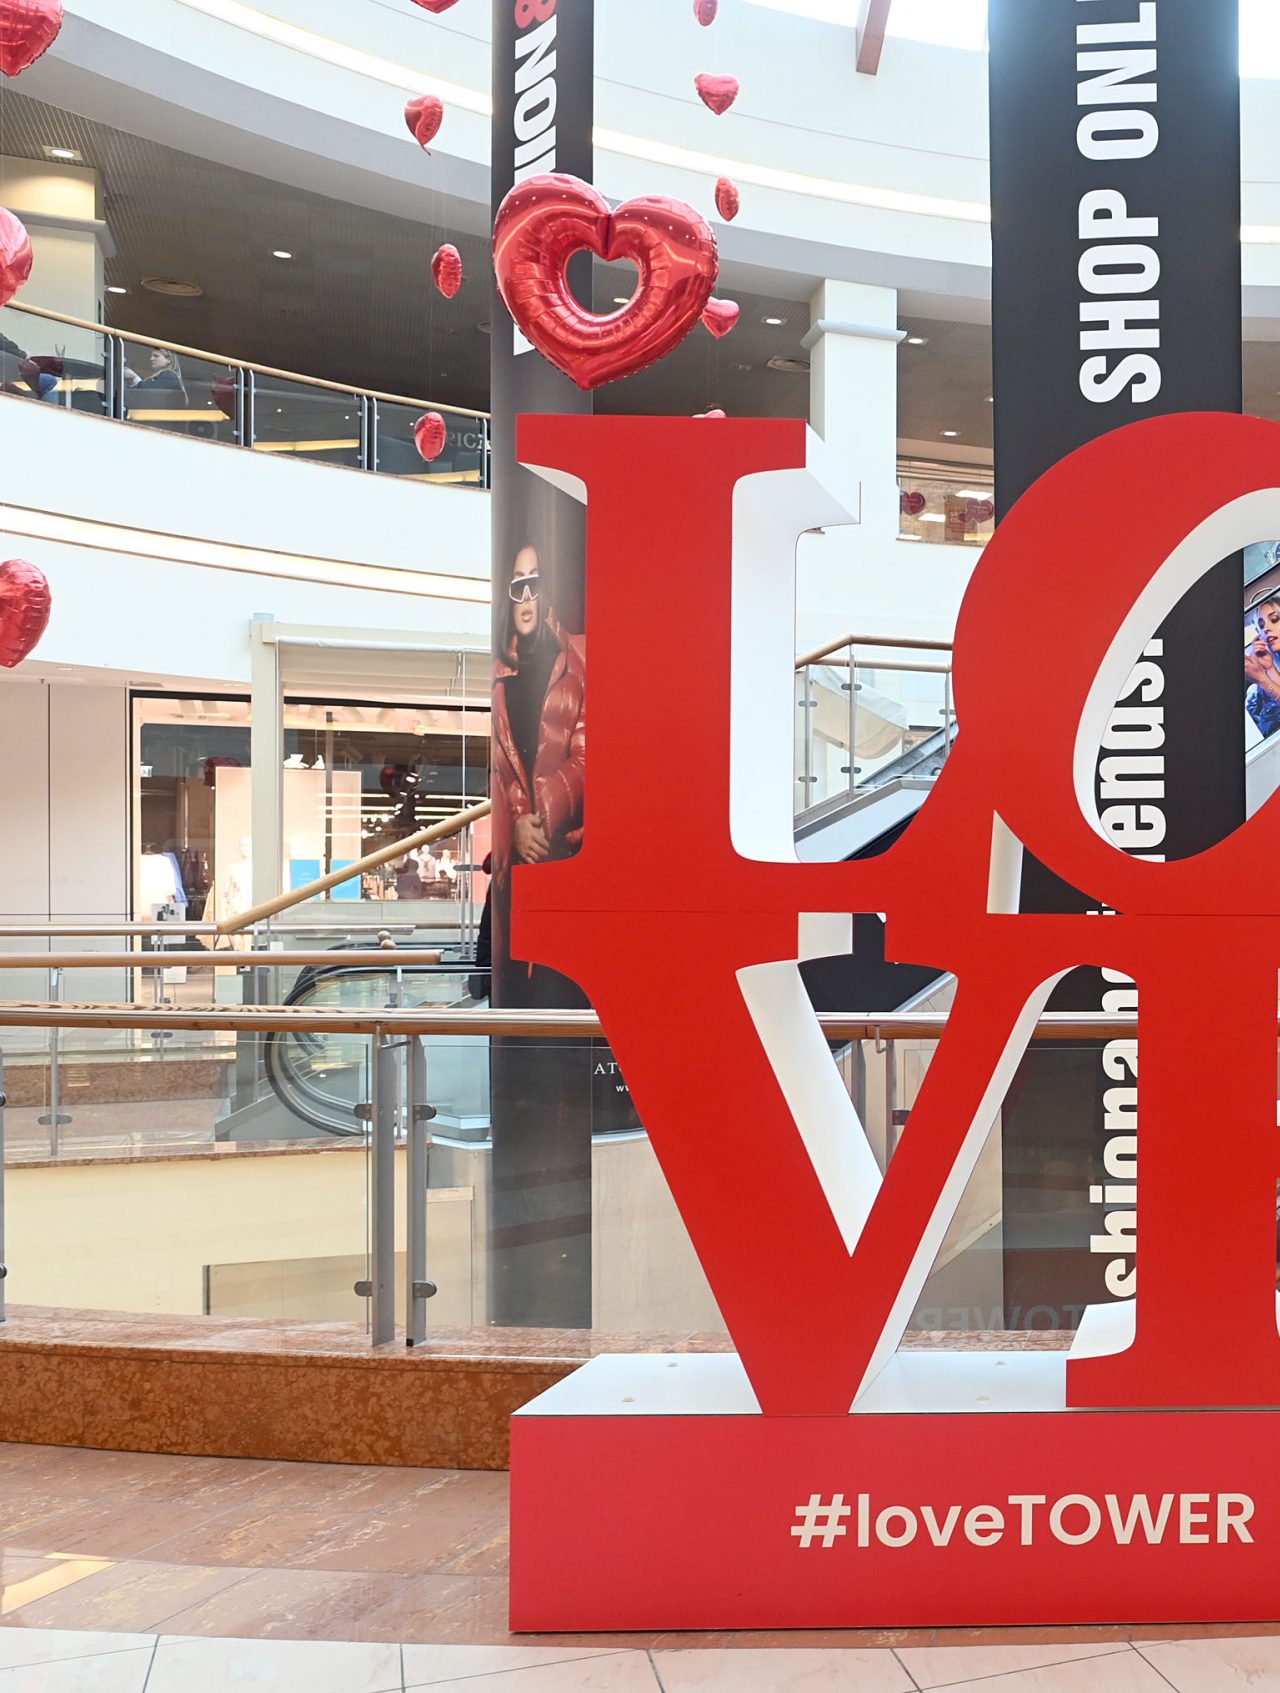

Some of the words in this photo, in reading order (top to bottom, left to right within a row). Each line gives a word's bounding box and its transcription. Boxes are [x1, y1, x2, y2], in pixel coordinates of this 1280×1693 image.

[1075, 0, 1160, 161] ONL
[1077, 188, 1162, 403] SHOP
[790, 1492, 1256, 1549] #loveTOWER
